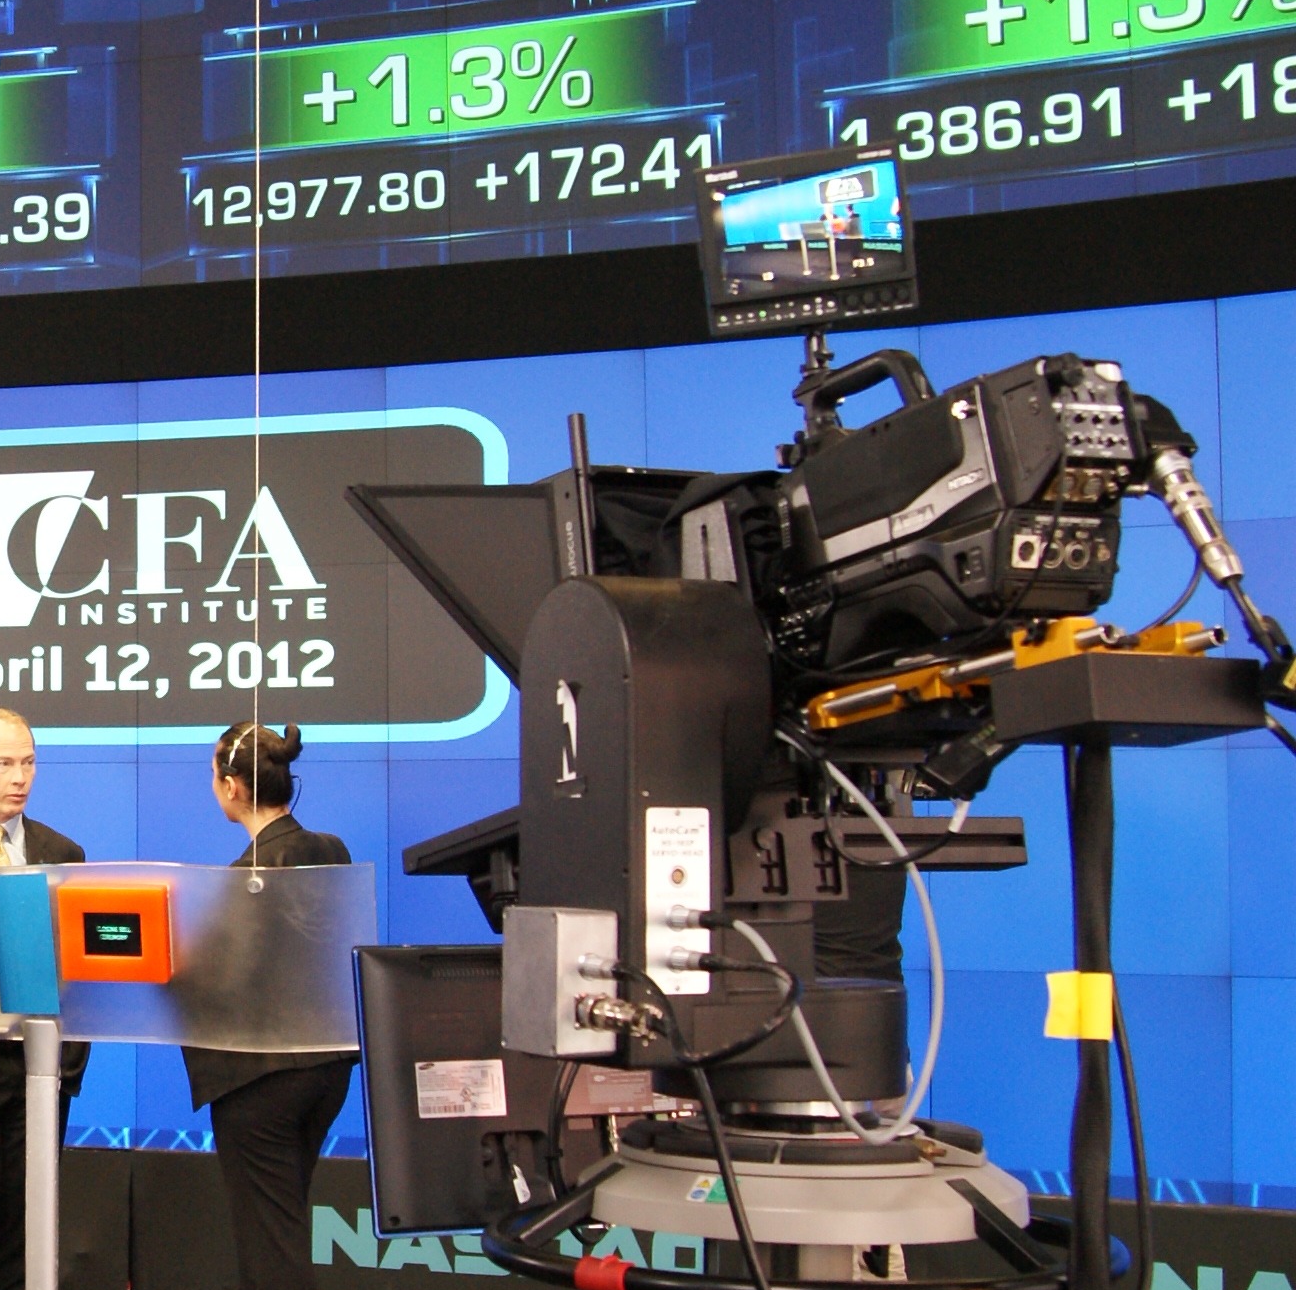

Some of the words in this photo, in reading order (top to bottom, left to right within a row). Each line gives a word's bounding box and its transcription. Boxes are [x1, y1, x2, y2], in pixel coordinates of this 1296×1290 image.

[304, 35, 594, 126] +1.3%
[840, 87, 1123, 160] 1386.91
[192, 170, 446, 228] 12,977.80
[476, 134, 714, 203] +172.41
[7, 485, 328, 598] CFA
[565, 521, 577, 576] utocue
[57, 597, 327, 625] INSTITUTE
[85, 644, 170, 699] 12,
[188, 639, 336, 689] 2012
